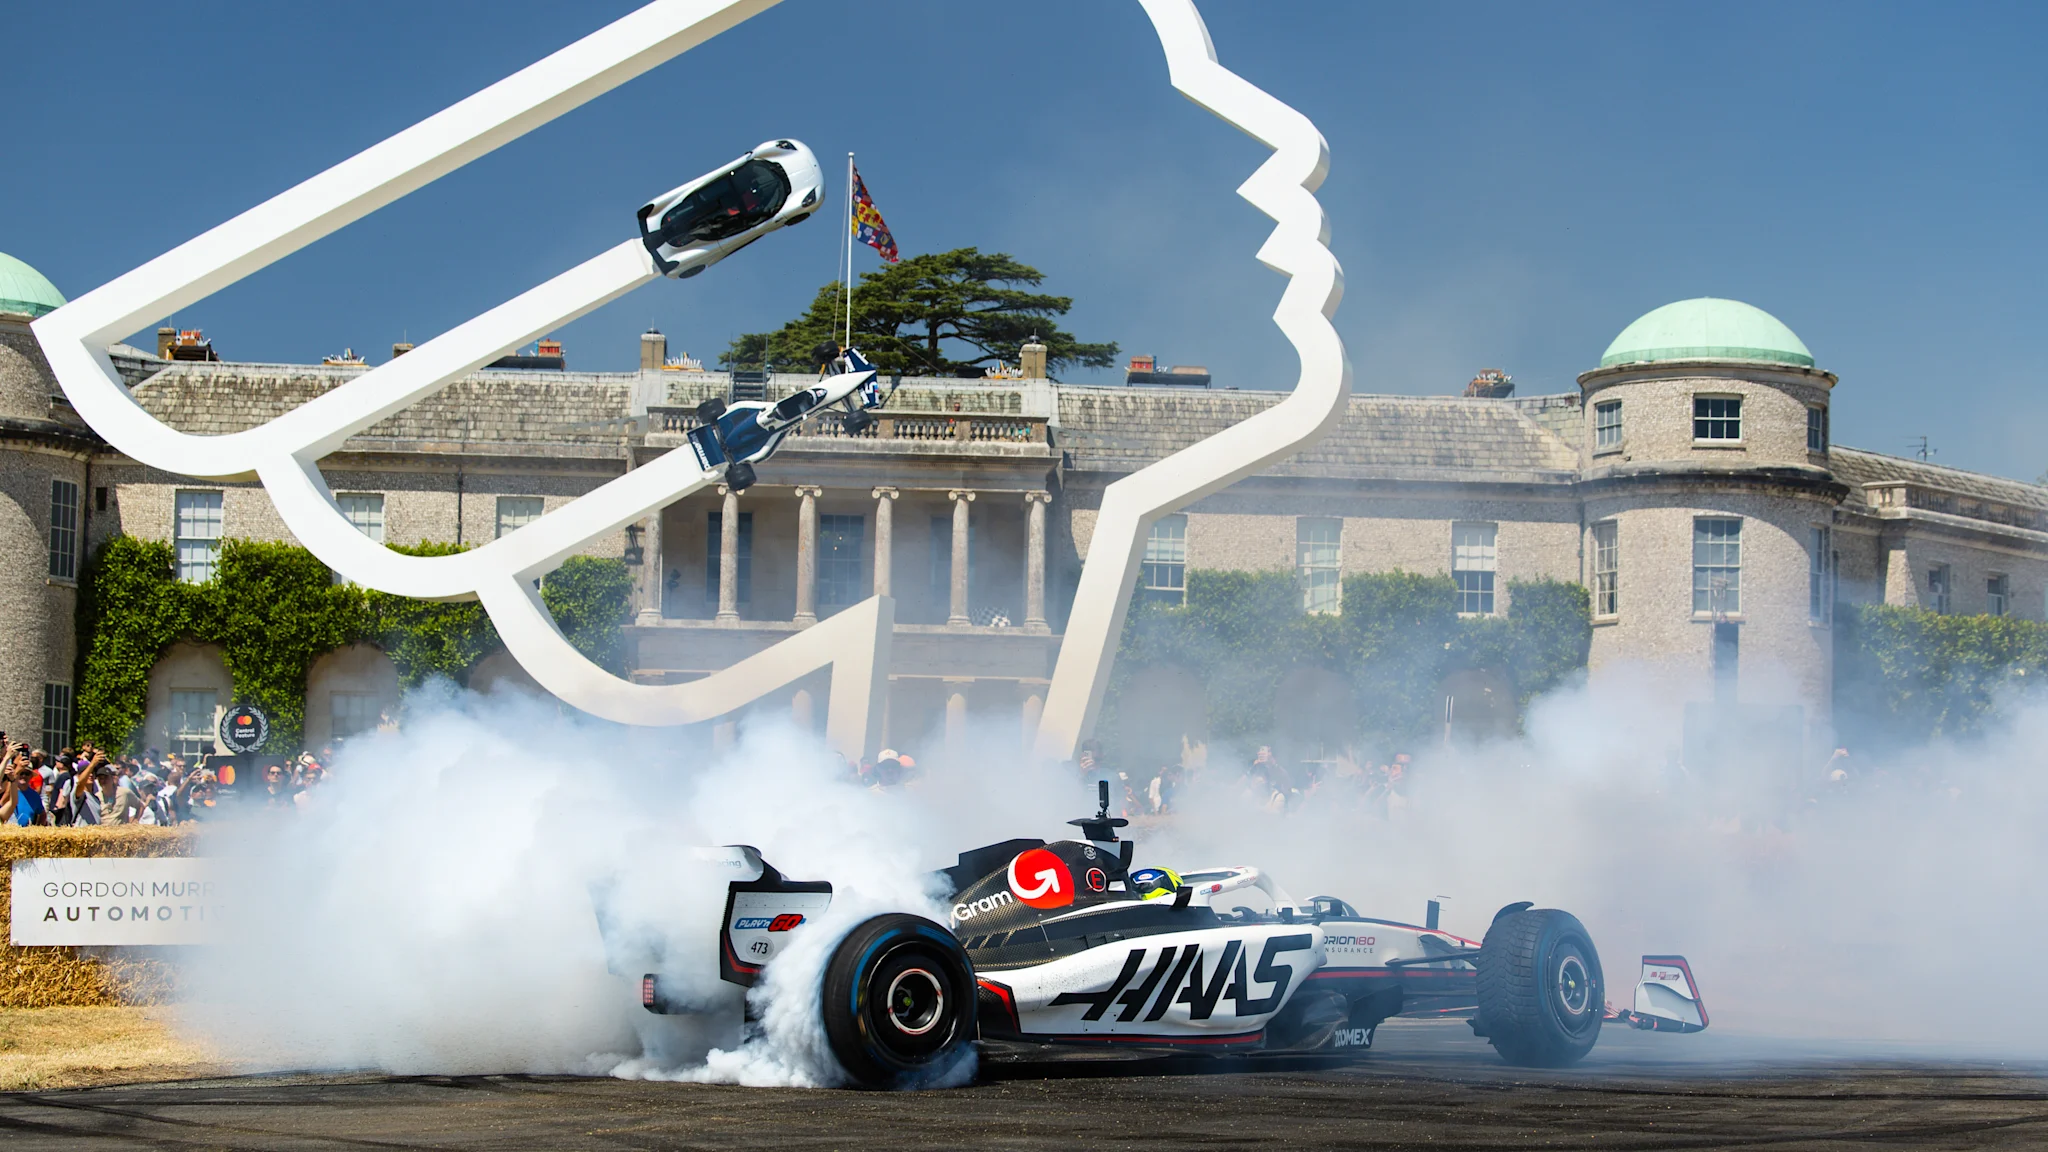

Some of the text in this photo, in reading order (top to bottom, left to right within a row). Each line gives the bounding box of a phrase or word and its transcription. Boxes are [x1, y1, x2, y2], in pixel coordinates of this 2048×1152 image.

[714, 858, 742, 869] acing
[43, 882, 217, 898] GORDON MURR
[43, 906, 225, 922] AUTOMOTIV
[950, 890, 1013, 929] yGram
[769, 914, 802, 932] GO
[751, 942, 769, 954] 473
[1048, 933, 1313, 1022] HAAS
[1335, 1028, 1371, 1047] ZOOMEX
